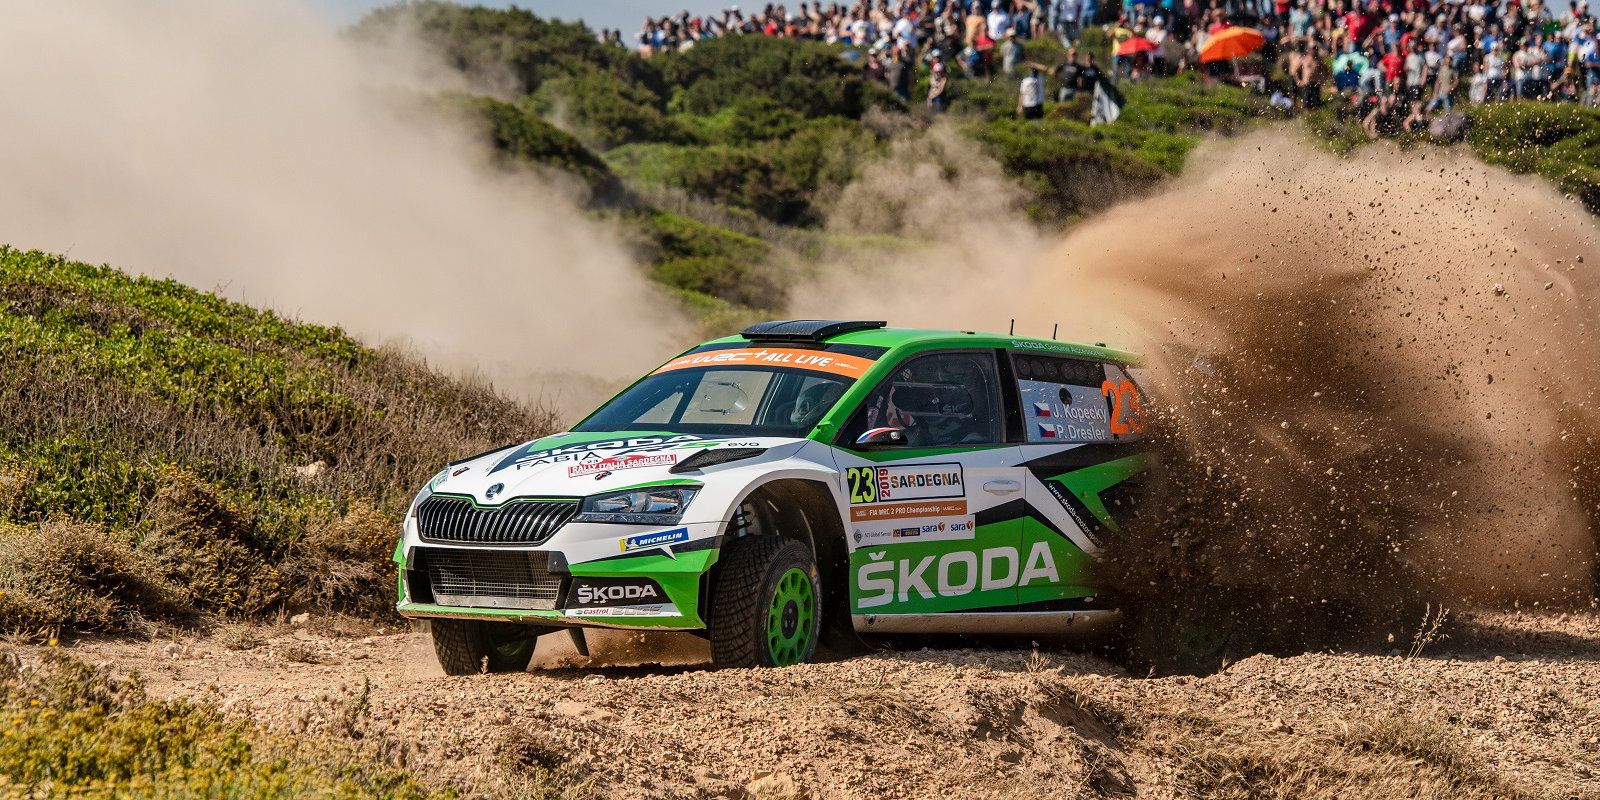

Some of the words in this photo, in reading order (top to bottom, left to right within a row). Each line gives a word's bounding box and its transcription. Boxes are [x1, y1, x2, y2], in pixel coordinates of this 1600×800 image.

[764, 352, 793, 363] ALL
[794, 354, 834, 368] LIVE
[1063, 403, 1108, 424] Kopecký
[1101, 379, 1147, 435] 23
[1056, 425, 1067, 439] P.
[1069, 424, 1106, 440] Dresler
[516, 451, 604, 471] FABIA
[572, 462, 600, 474] RALLY
[598, 459, 627, 471] ITALIA
[627, 454, 673, 467] SARDEGNA
[847, 467, 876, 503] 23
[879, 468, 891, 498] 2019
[891, 472, 961, 489] SARDEGNA
[906, 505, 941, 514] Championship
[921, 524, 937, 533] sara
[950, 523, 966, 532] sara
[639, 532, 683, 546] MICHELIN
[857, 541, 1060, 609] ŠKODA
[577, 584, 657, 602] ŠKODA
